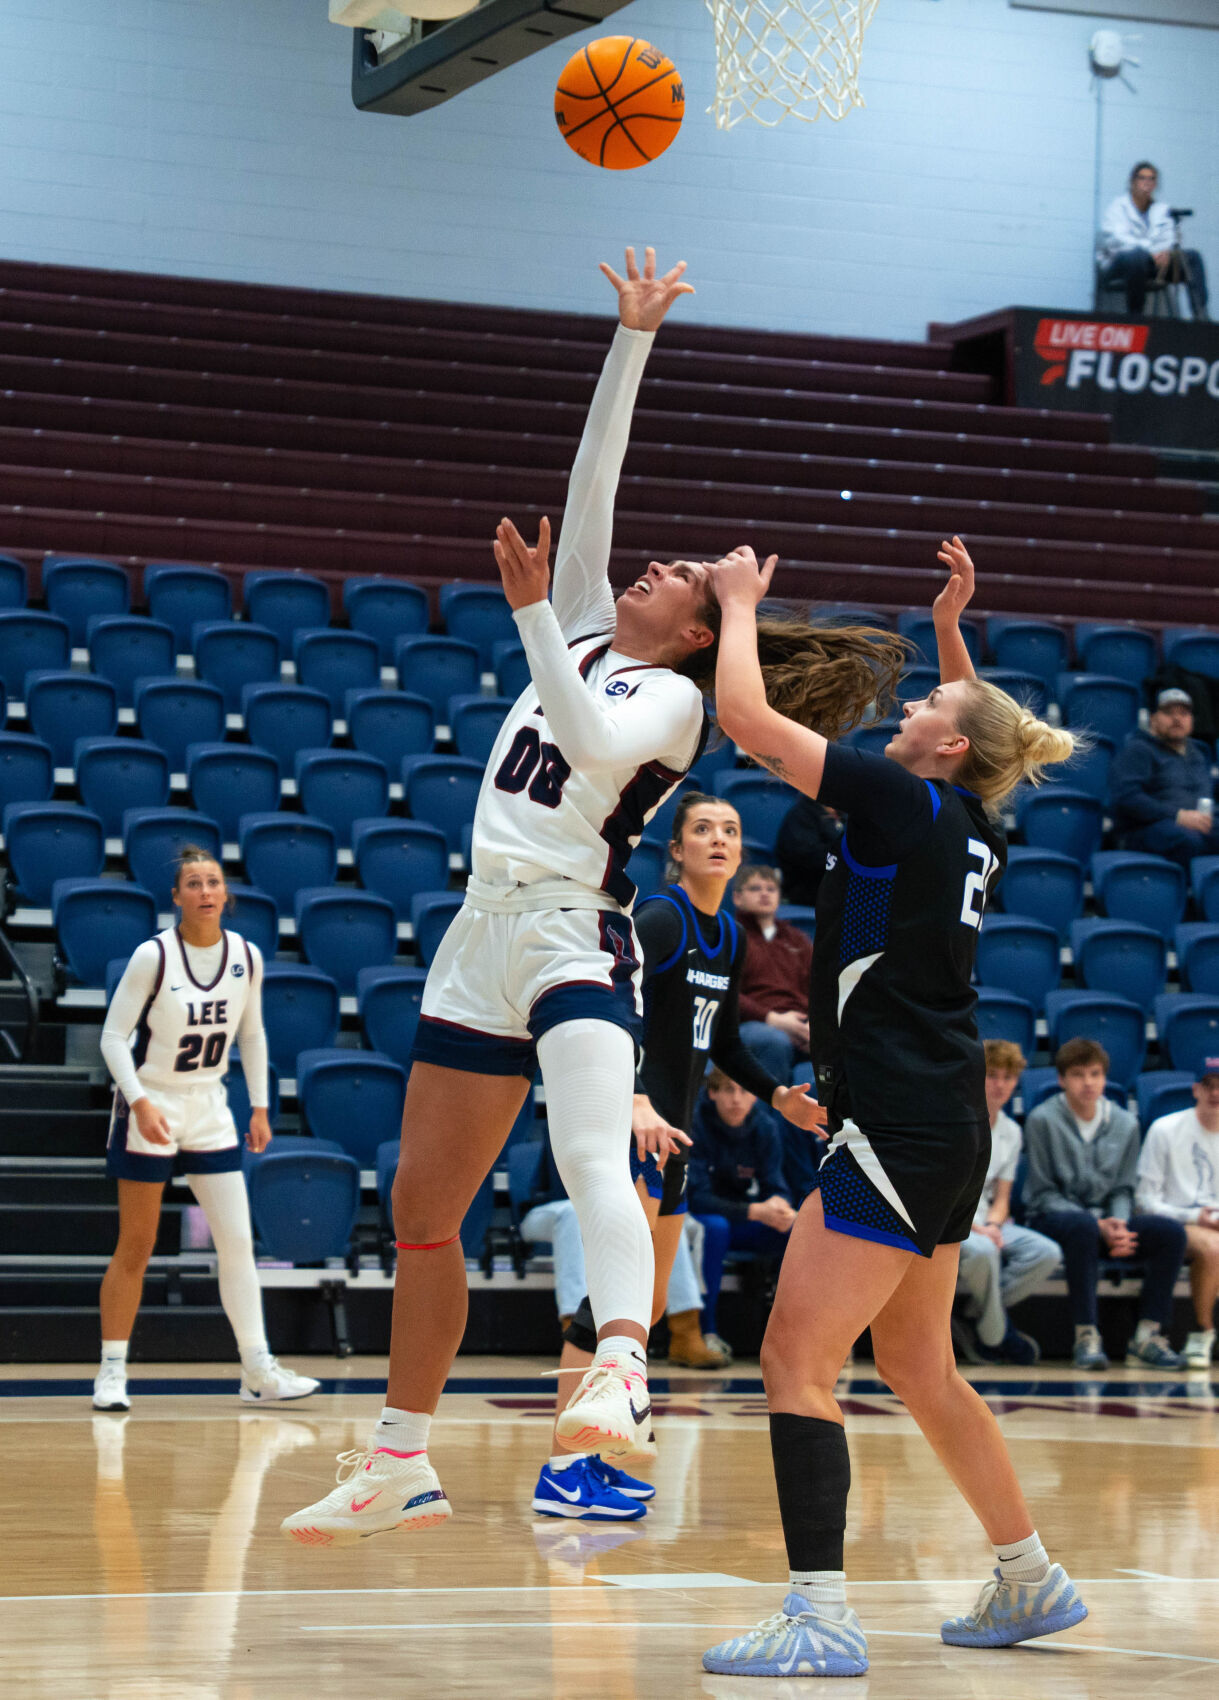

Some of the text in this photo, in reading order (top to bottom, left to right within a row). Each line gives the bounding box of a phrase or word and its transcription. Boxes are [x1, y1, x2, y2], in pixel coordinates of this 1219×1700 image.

[1049, 322, 1135, 348] LIVE ON
[186, 999, 228, 1026] LEE
[173, 1031, 227, 1072] 20
